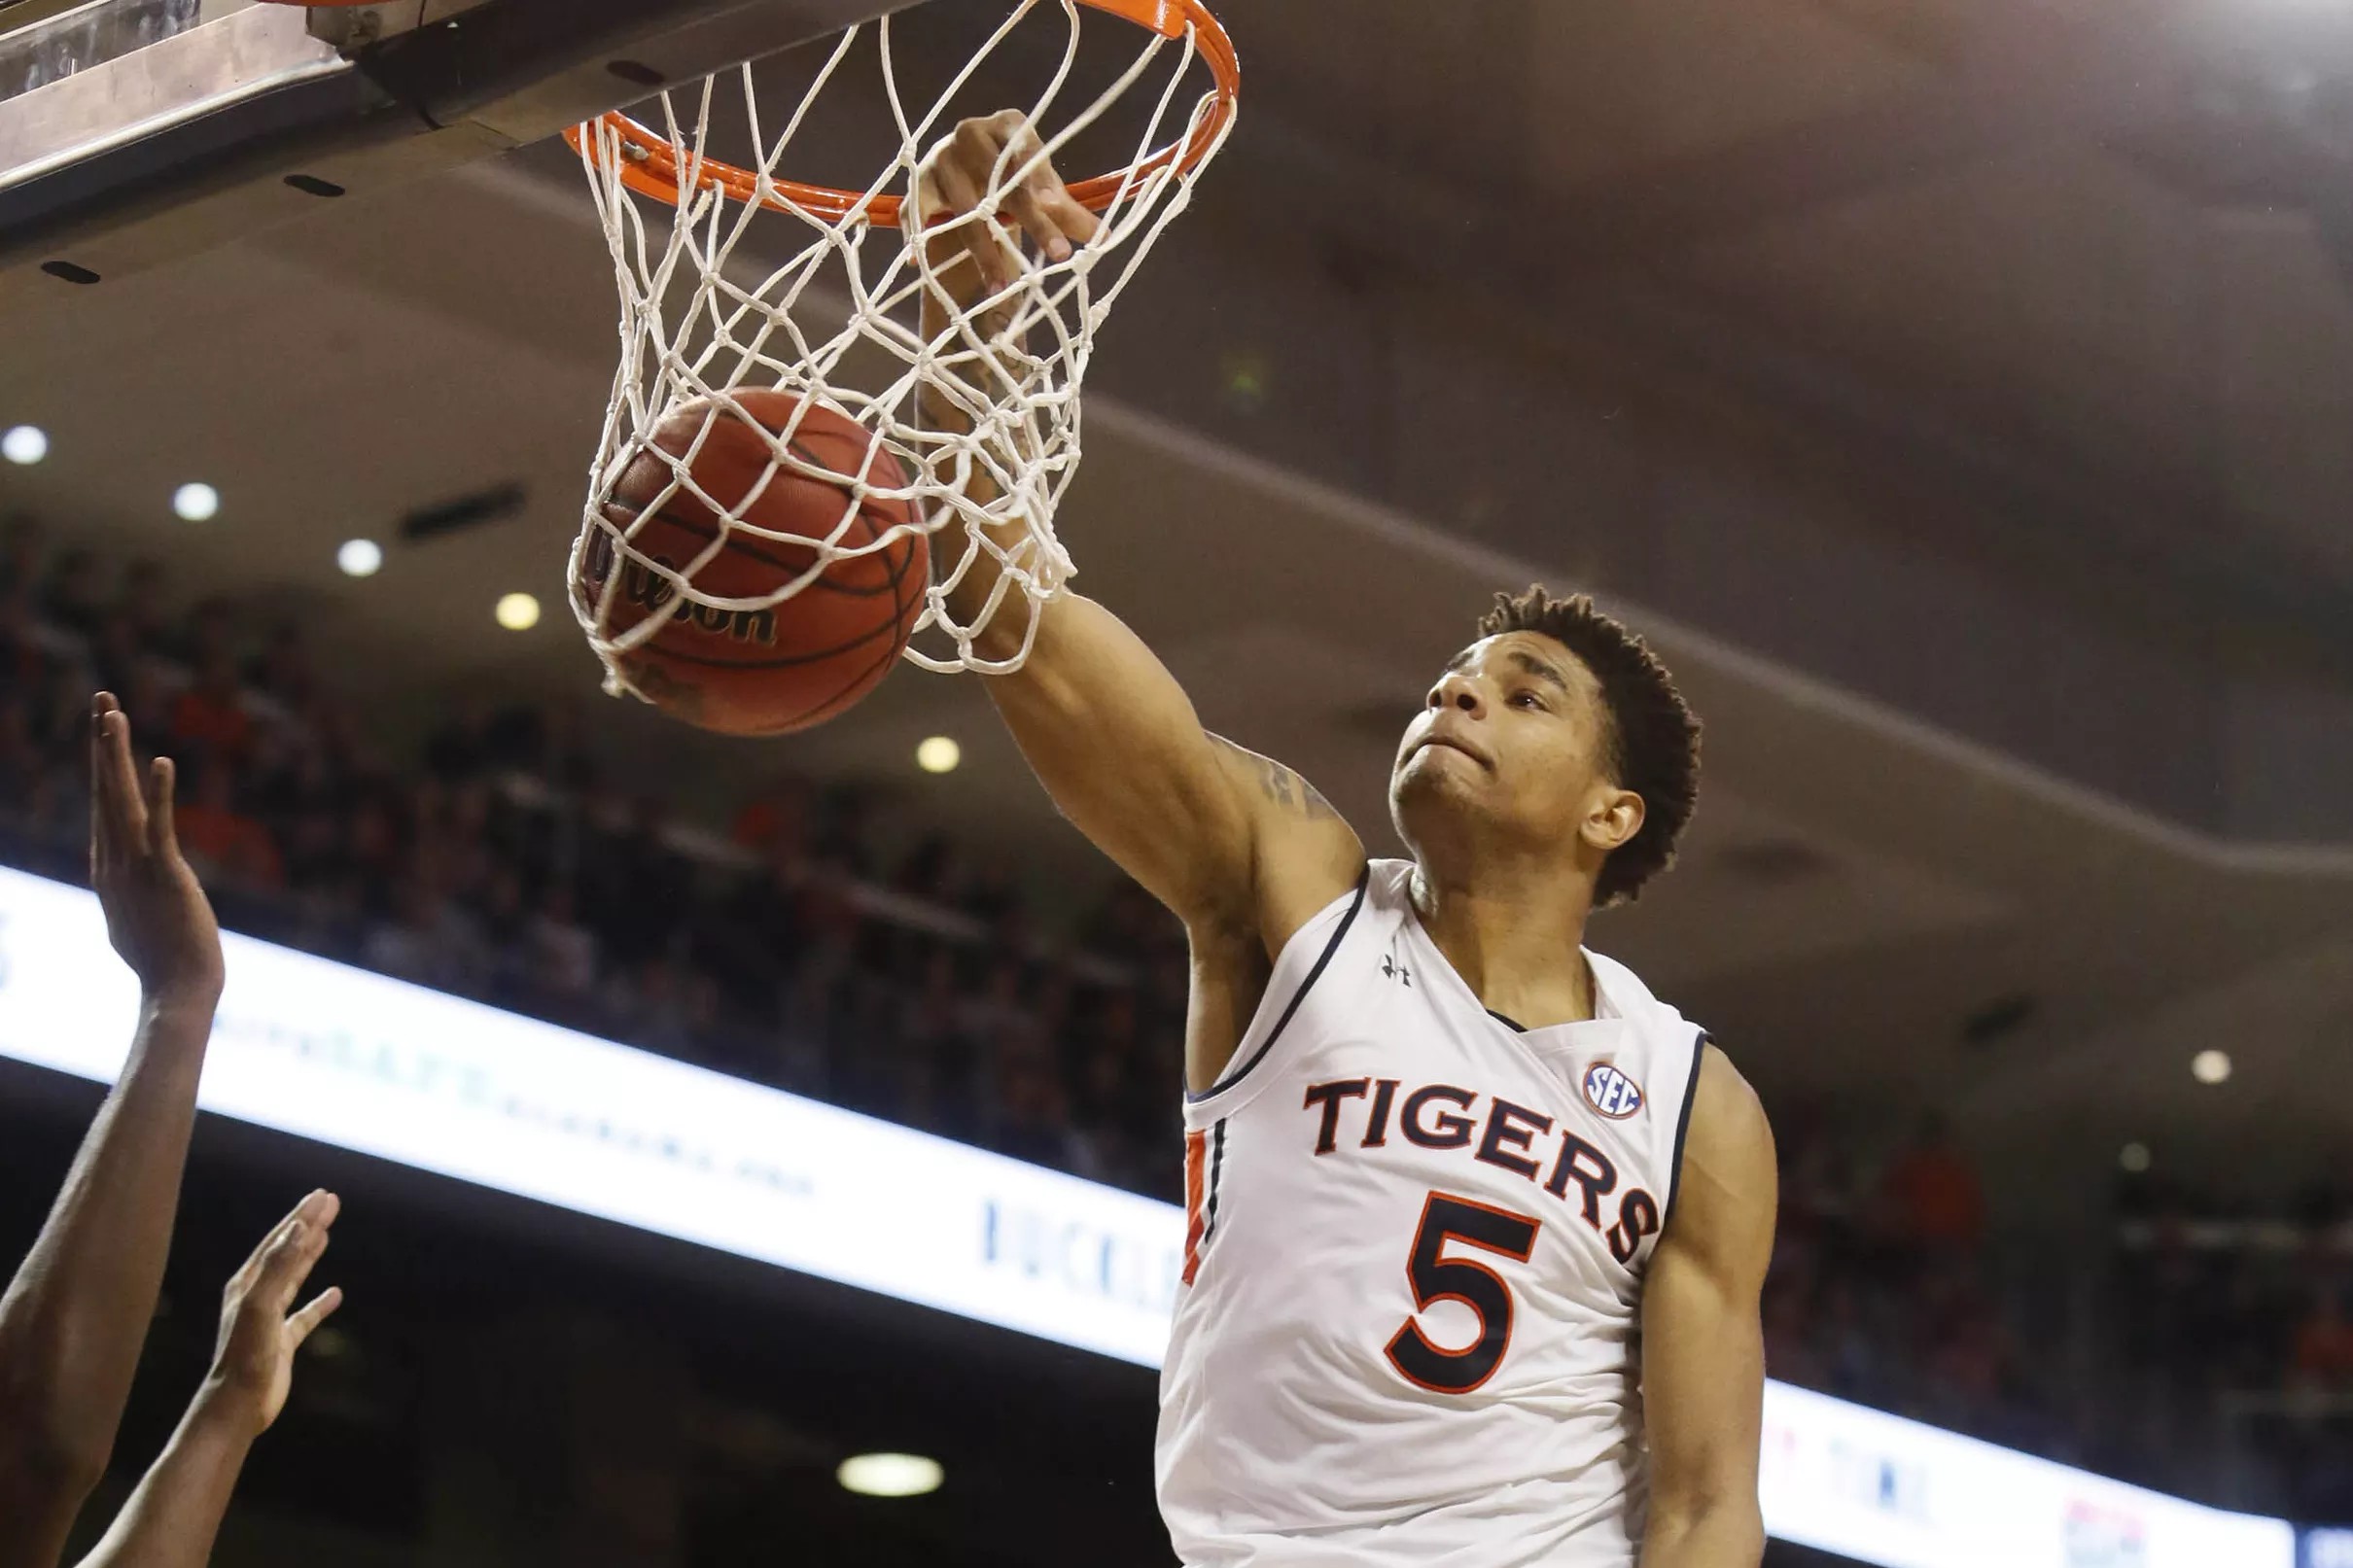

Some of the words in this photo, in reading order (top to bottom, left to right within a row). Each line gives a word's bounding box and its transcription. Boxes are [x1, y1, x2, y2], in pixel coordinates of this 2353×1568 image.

[1303, 1077, 1660, 1265] TIGERS
[1587, 1066, 1639, 1115] SEC
[1384, 1190, 1542, 1394] 5
